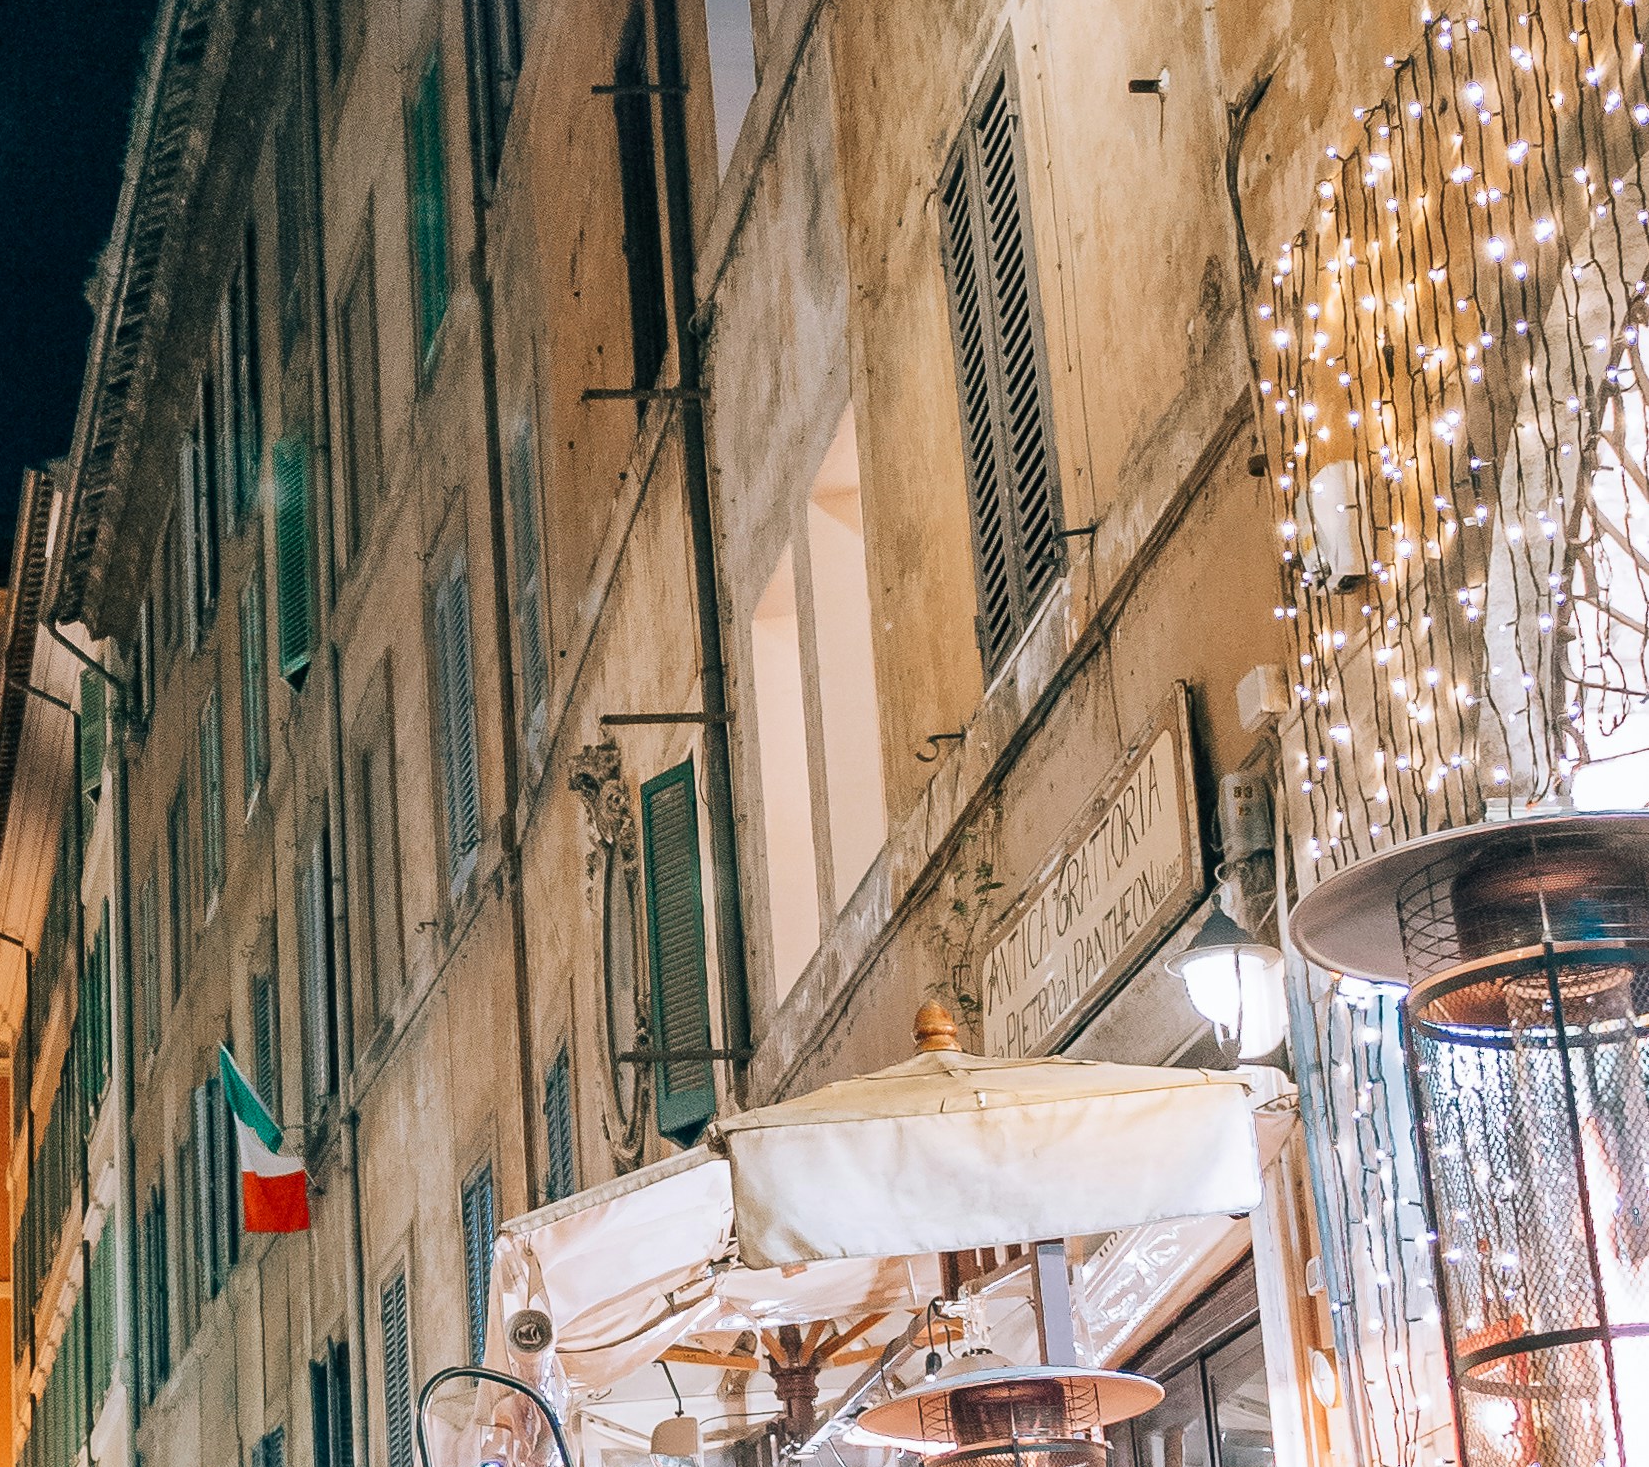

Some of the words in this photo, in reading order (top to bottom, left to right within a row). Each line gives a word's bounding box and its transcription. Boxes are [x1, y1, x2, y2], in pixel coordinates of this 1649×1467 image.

[986, 897, 1050, 1016] ANTICA
[1006, 979, 1057, 1058] PIETRO
[1058, 955, 1072, 1015] al
[1073, 861, 1156, 998] PANTHEON
